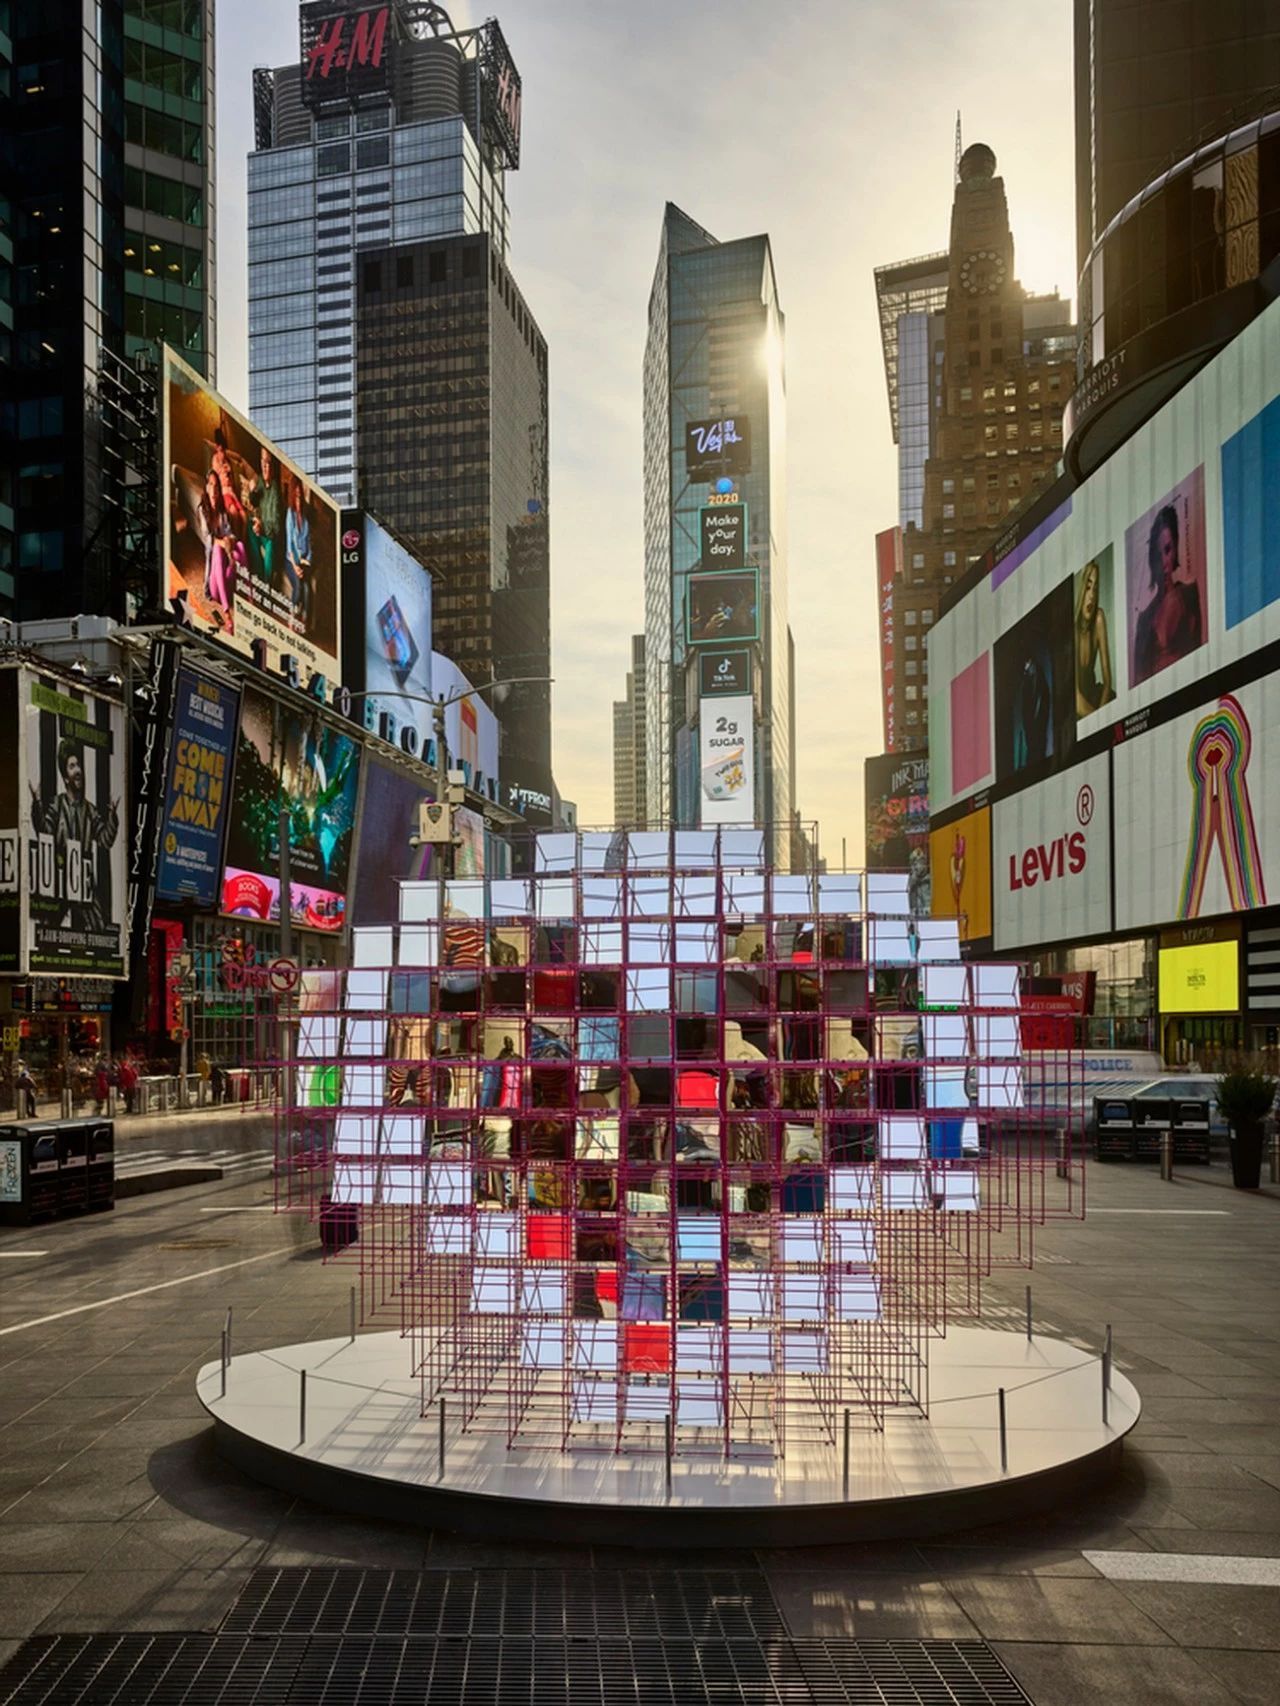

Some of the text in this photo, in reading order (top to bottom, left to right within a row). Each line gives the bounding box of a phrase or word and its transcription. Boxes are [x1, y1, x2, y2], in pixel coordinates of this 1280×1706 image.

[306, 7, 390, 80] H&M
[708, 493, 739, 505] 2020
[706, 515, 739, 527] Make
[708, 529, 736, 542] your
[343, 552, 360, 563] LG
[710, 544, 735, 556] day.
[236, 600, 251, 620] Then
[253, 614, 262, 628] go
[262, 619, 278, 635] back
[278, 627, 286, 642] to
[715, 717, 738, 735] 2g
[709, 737, 745, 748] SUGAR
[363, 695, 500, 806] BROAWAY
[177, 740, 226, 779] COME
[892, 766, 912, 793] INK
[170, 794, 221, 830] AWAY
[1081, 1058, 1134, 1071] POLICE
